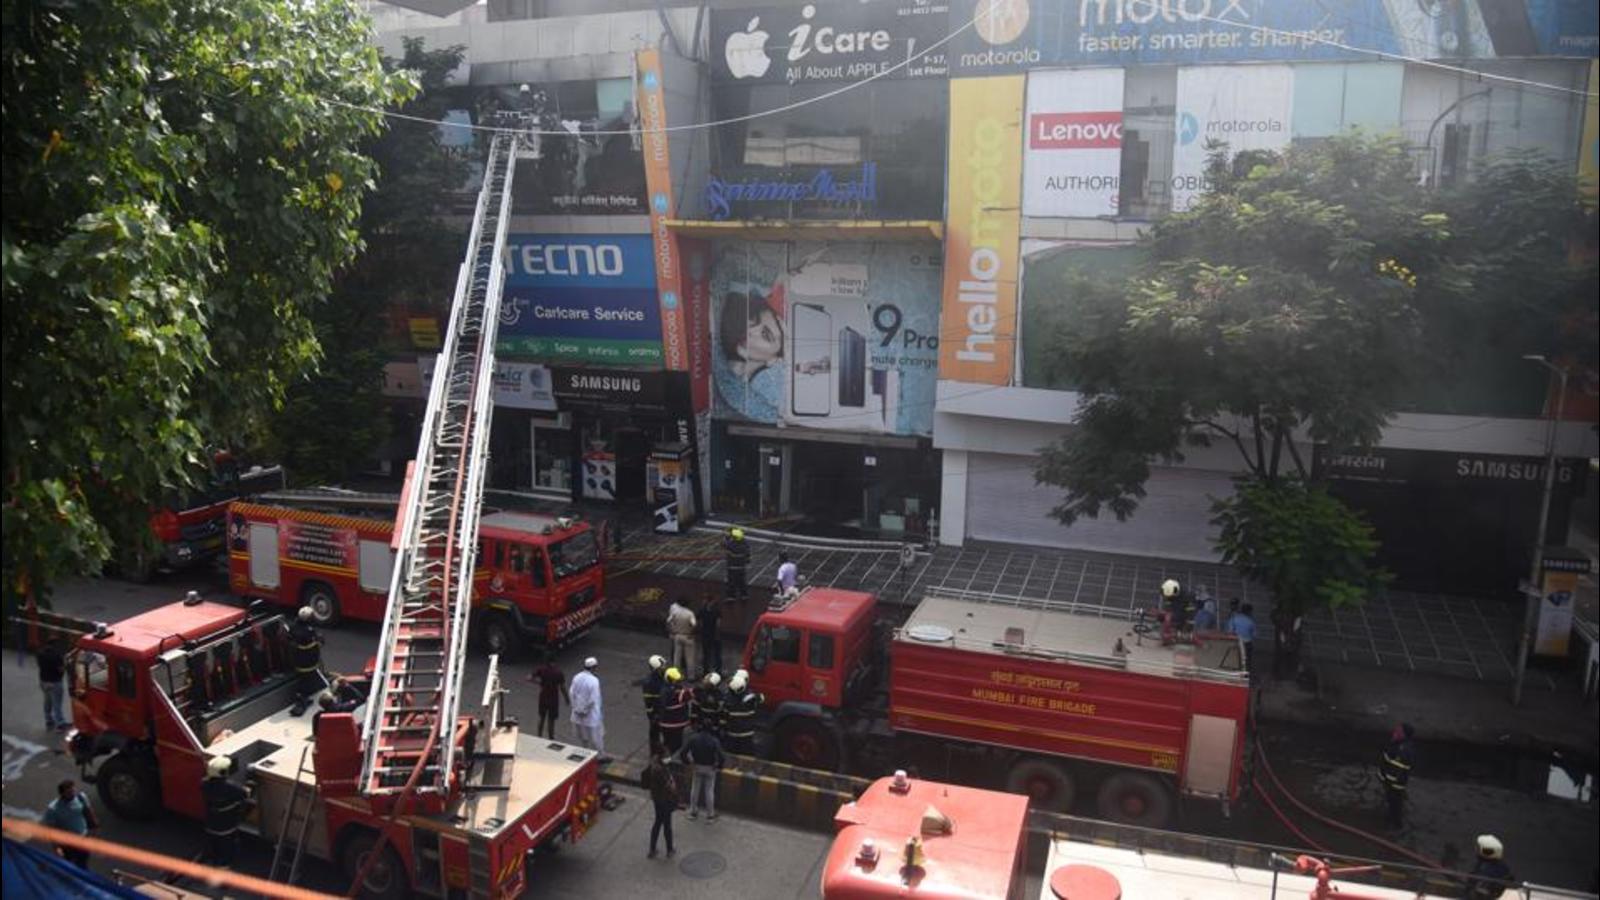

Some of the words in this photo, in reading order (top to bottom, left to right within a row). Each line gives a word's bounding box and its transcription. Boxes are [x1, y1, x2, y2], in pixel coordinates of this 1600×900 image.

[1079, 32, 1142, 52] faster.
[1149, 30, 1242, 50] smarter.
[960, 47, 1041, 67] motorola
[805, 66, 843, 79] About
[846, 61, 890, 77] APPLE
[1206, 117, 1282, 133] motorola
[1044, 175, 1119, 191] AUTHORI
[658, 214, 672, 279] motorola
[504, 243, 625, 276] TECNO
[534, 305, 589, 320] Carlcare
[594, 305, 644, 321] Service
[903, 329, 939, 350] Pro
[570, 374, 642, 393] SAMSUNG
[972, 688, 1015, 704] MUMBAI
[1019, 694, 1046, 707] FIRE
[1048, 699, 1097, 715] BRIGADE
